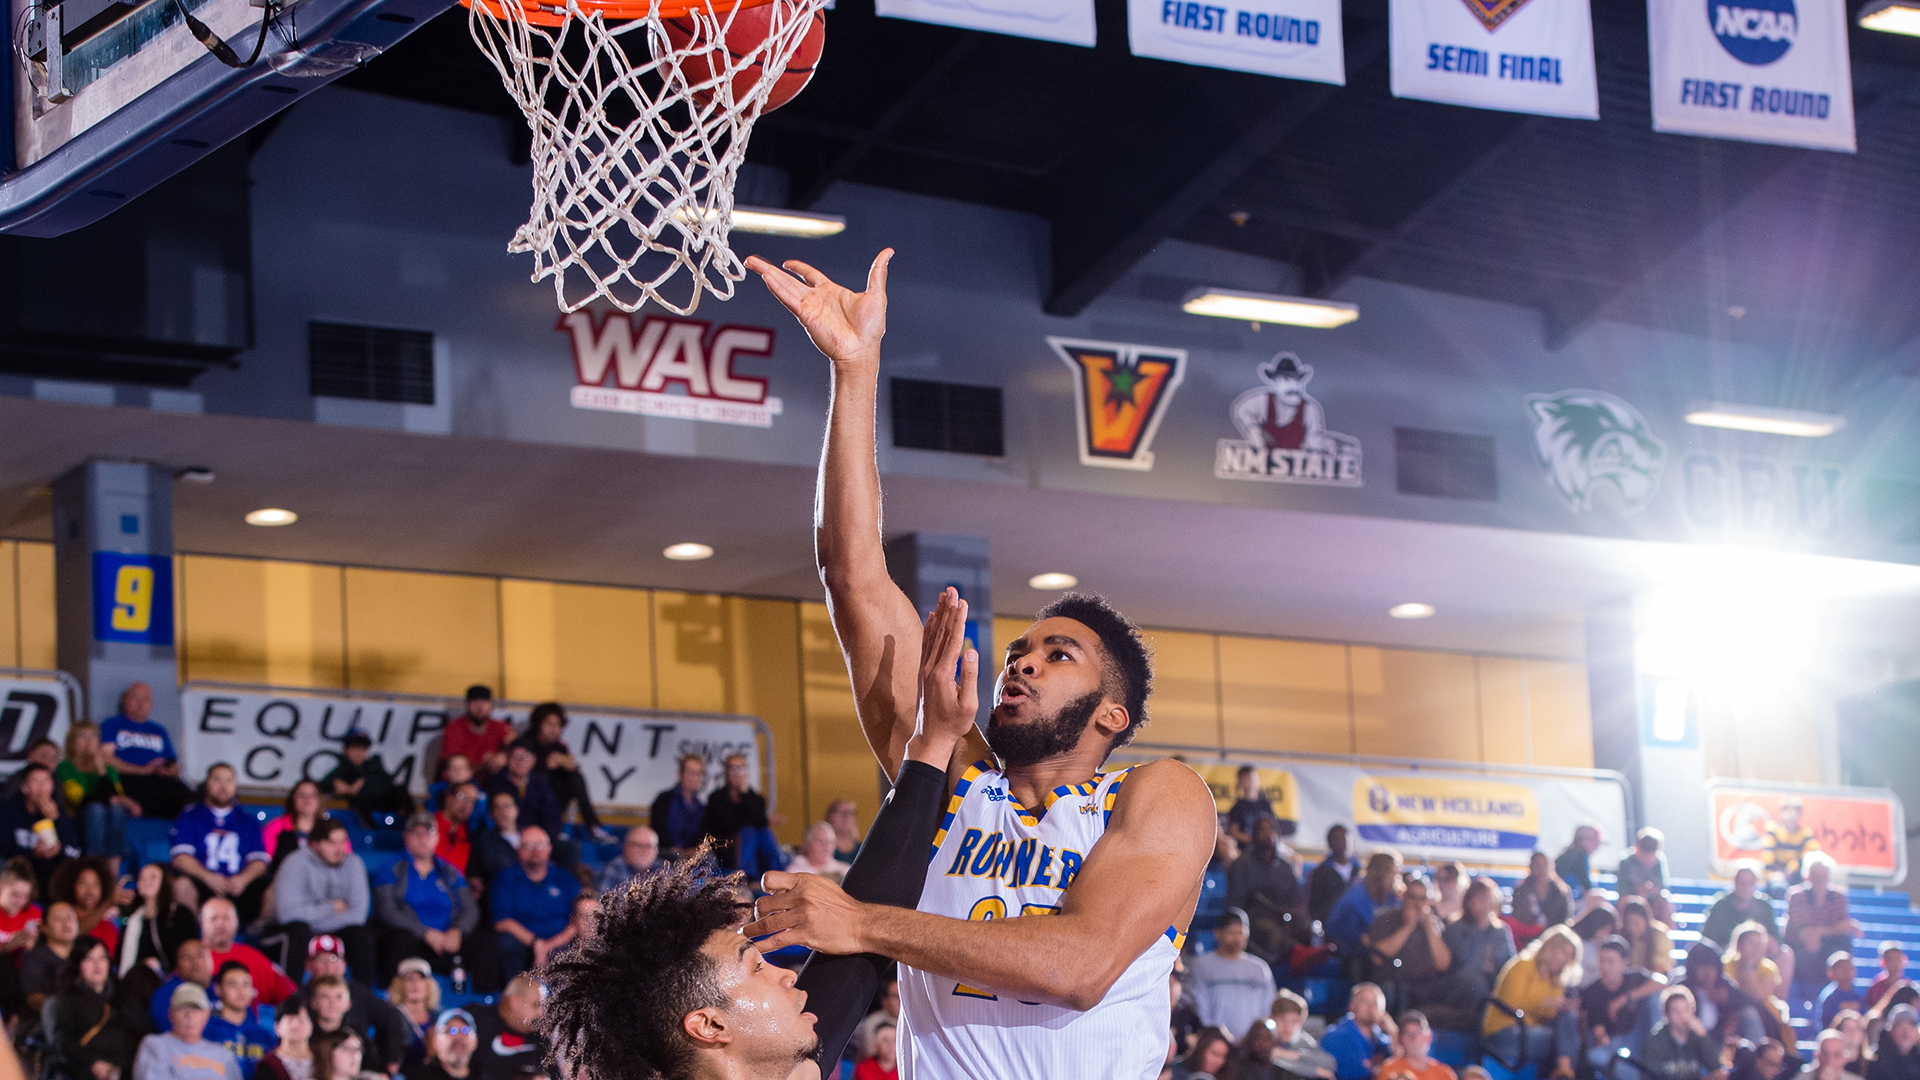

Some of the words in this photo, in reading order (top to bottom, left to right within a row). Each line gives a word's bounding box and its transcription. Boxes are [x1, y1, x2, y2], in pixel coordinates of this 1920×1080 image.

[1163, 0, 1227, 34] FIRST
[1236, 11, 1319, 46] ROUND
[1715, 5, 1797, 42] NCAA
[1427, 43, 1489, 77] SEMI
[1498, 53, 1562, 85] FINAL
[1681, 77, 1743, 110] FIRST
[1751, 86, 1831, 121] ROUND
[558, 310, 774, 403] WAC
[1269, 447, 1360, 480] STATE
[111, 565, 154, 632] 9
[199, 697, 677, 758] EQUIPNT
[245, 745, 636, 799] COMY
[1442, 796, 1525, 817] HOLLAND
[204, 830, 241, 877] 14
[1396, 828, 1499, 848] AGRICULTURE
[1814, 822, 1888, 852] bota
